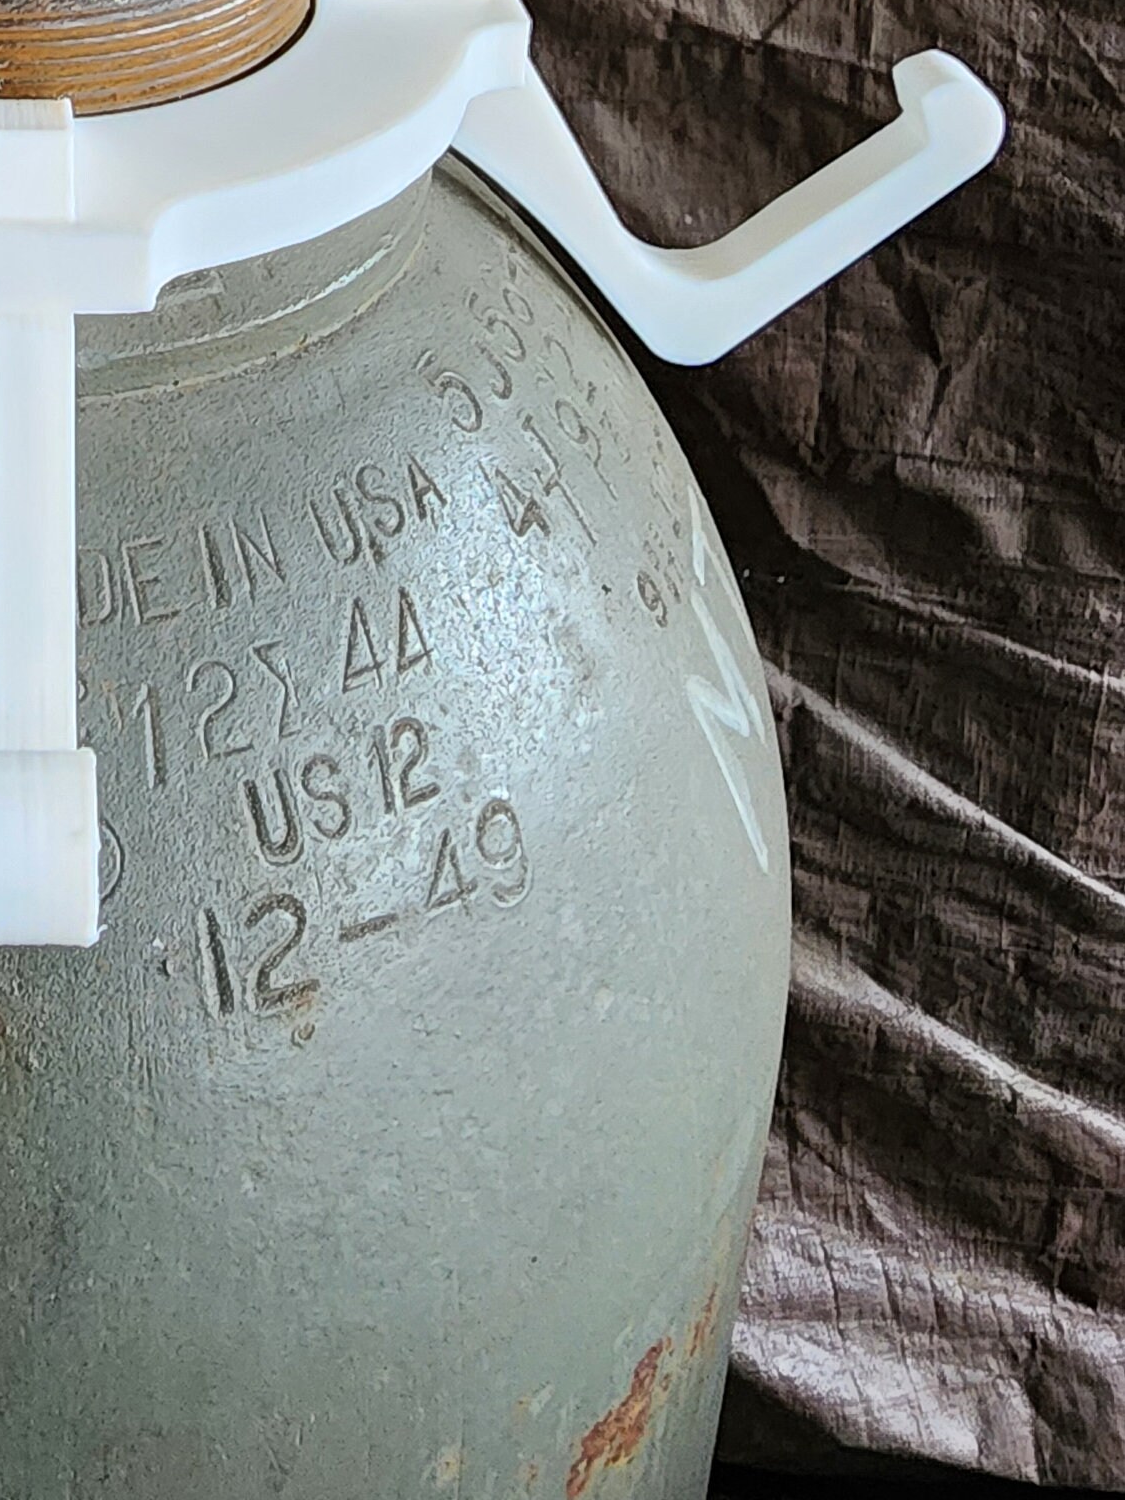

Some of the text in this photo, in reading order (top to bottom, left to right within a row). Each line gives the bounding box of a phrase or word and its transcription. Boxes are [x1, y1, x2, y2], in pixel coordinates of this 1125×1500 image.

[193, 512, 288, 610] IN
[308, 452, 448, 566] USA
[341, 585, 435, 695] 44
[245, 716, 442, 866] US 12
